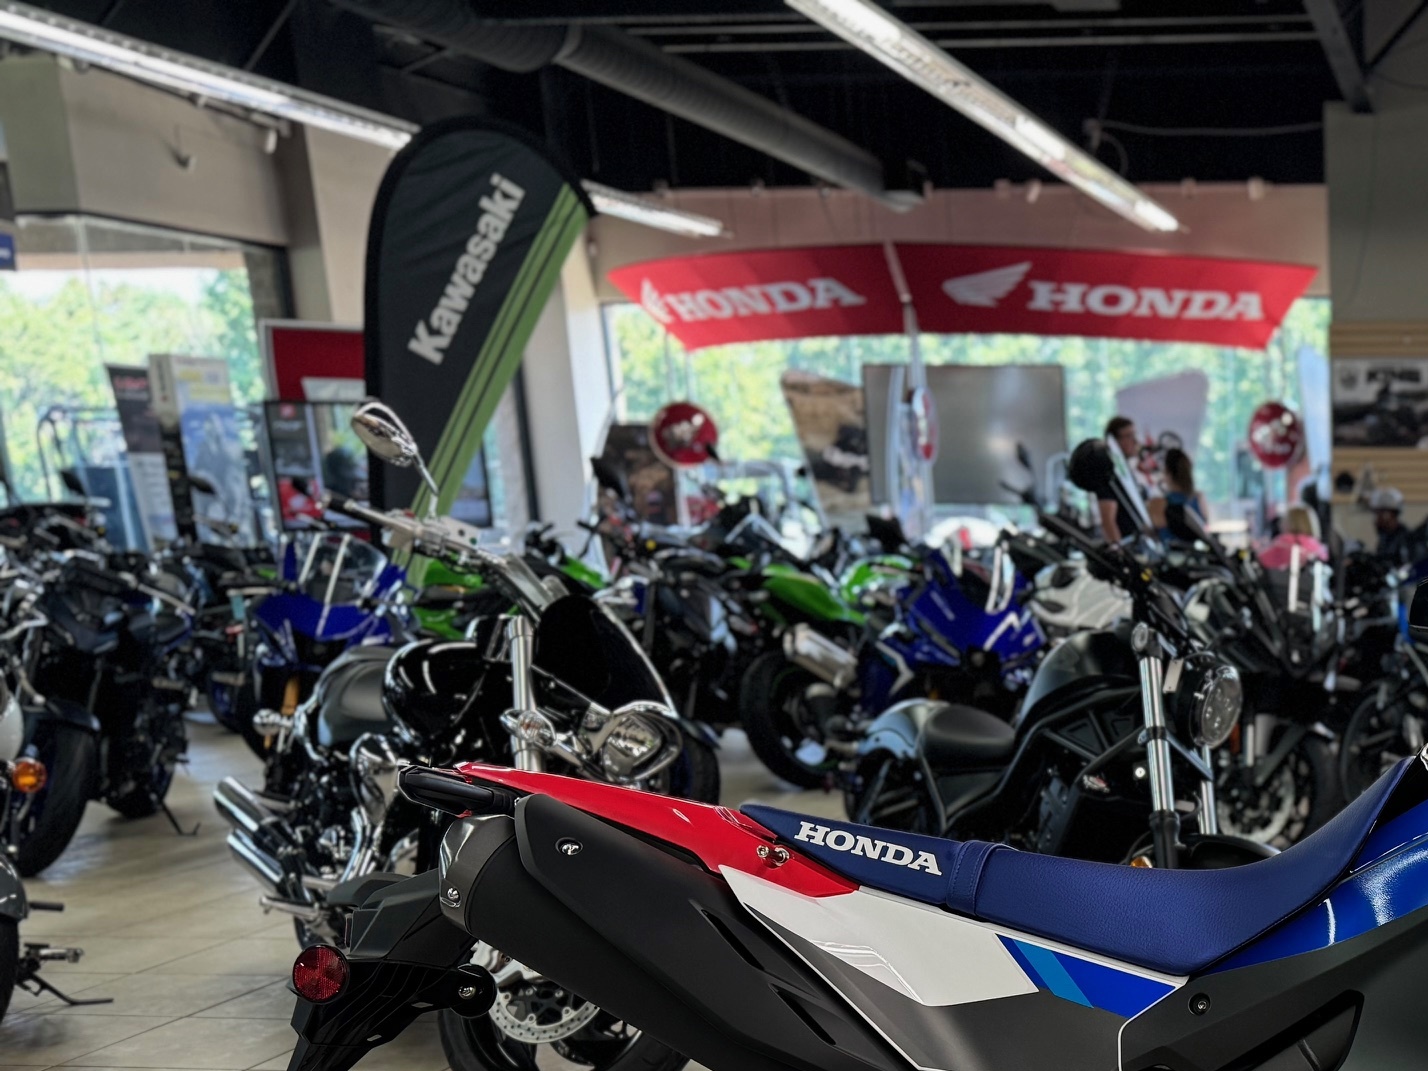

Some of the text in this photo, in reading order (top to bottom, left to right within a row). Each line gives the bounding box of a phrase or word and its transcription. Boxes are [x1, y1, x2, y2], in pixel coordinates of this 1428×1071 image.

[407, 173, 526, 365] Kawasaki
[664, 277, 867, 322] HONDA
[1027, 280, 1264, 320] HONDA
[794, 821, 942, 876] HONDA
